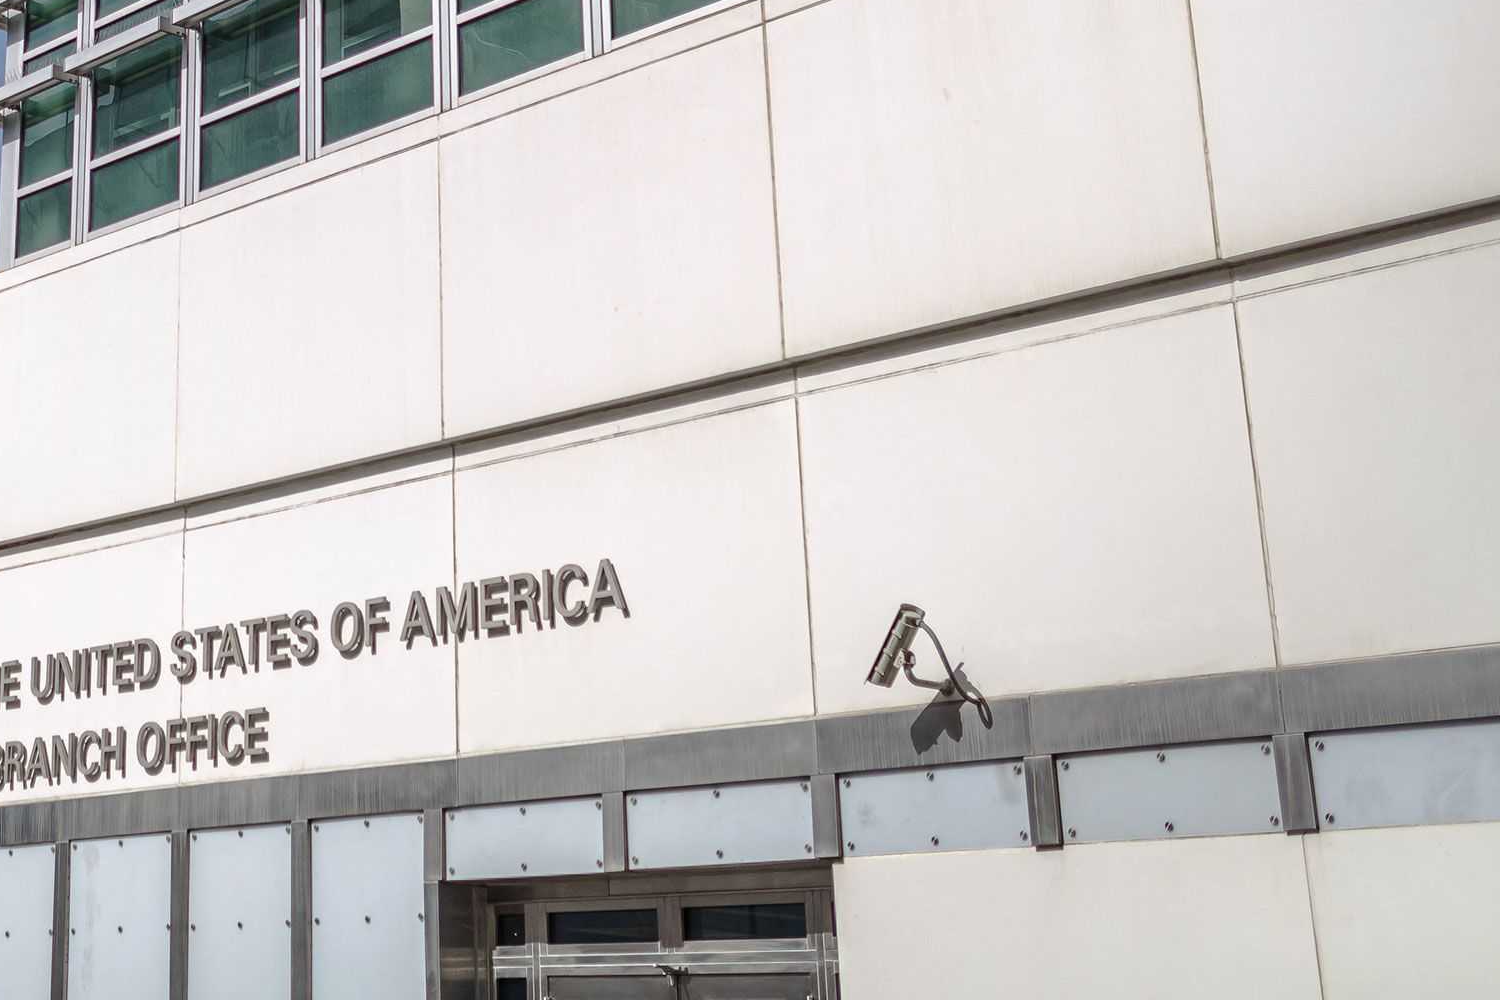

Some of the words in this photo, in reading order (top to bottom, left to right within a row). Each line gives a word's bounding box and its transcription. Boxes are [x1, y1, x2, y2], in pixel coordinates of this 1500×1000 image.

[31, 638, 161, 701] UNITED
[170, 609, 319, 684] STATES
[331, 596, 391, 660] OF
[400, 558, 631, 650] AMERICA
[136, 707, 270, 776] OFFICE
